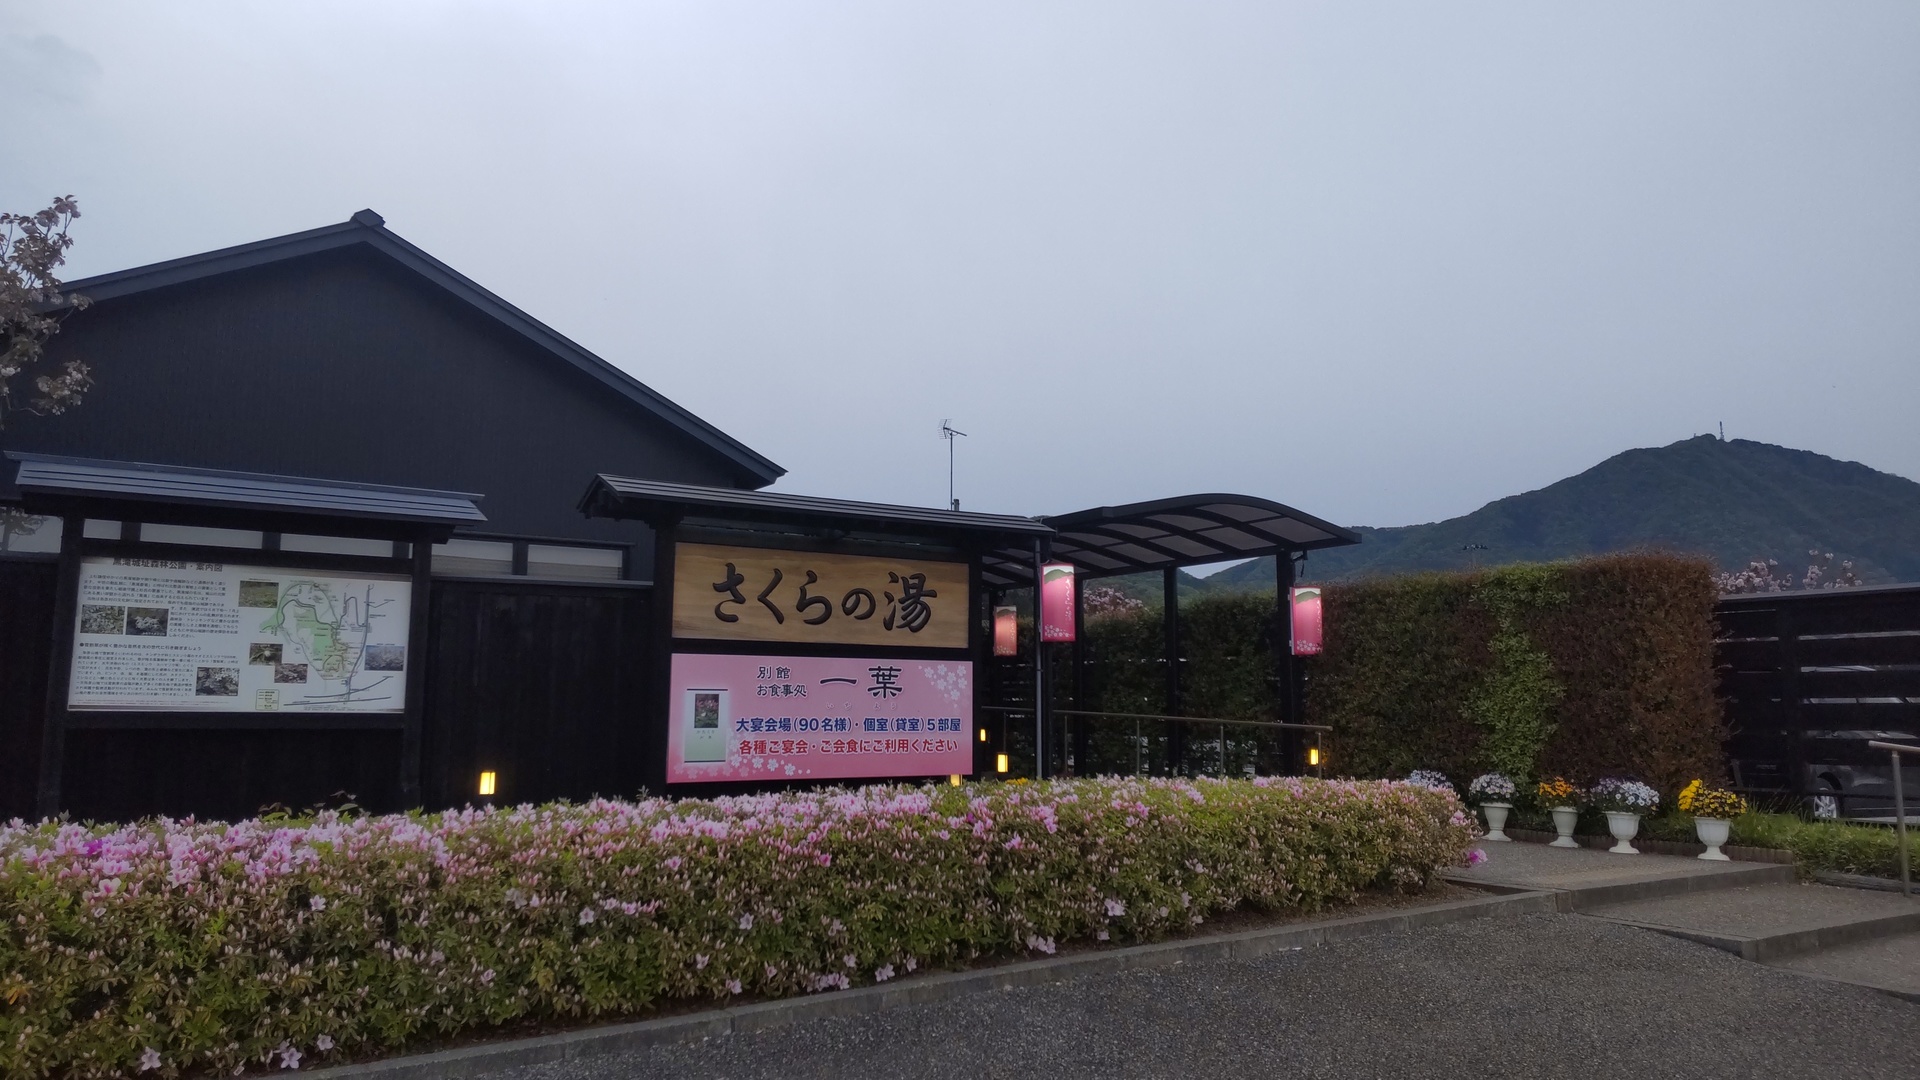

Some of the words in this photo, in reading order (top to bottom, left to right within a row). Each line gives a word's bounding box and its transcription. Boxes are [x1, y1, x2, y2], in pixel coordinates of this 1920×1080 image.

[712, 562, 938, 634] さくらの湯
[756, 665, 791, 679] 別館
[756, 684, 807, 697] お食事処
[819, 665, 903, 699] 一葉
[739, 738, 959, 755] 各種ご宴会・ご会食にご利用ください
